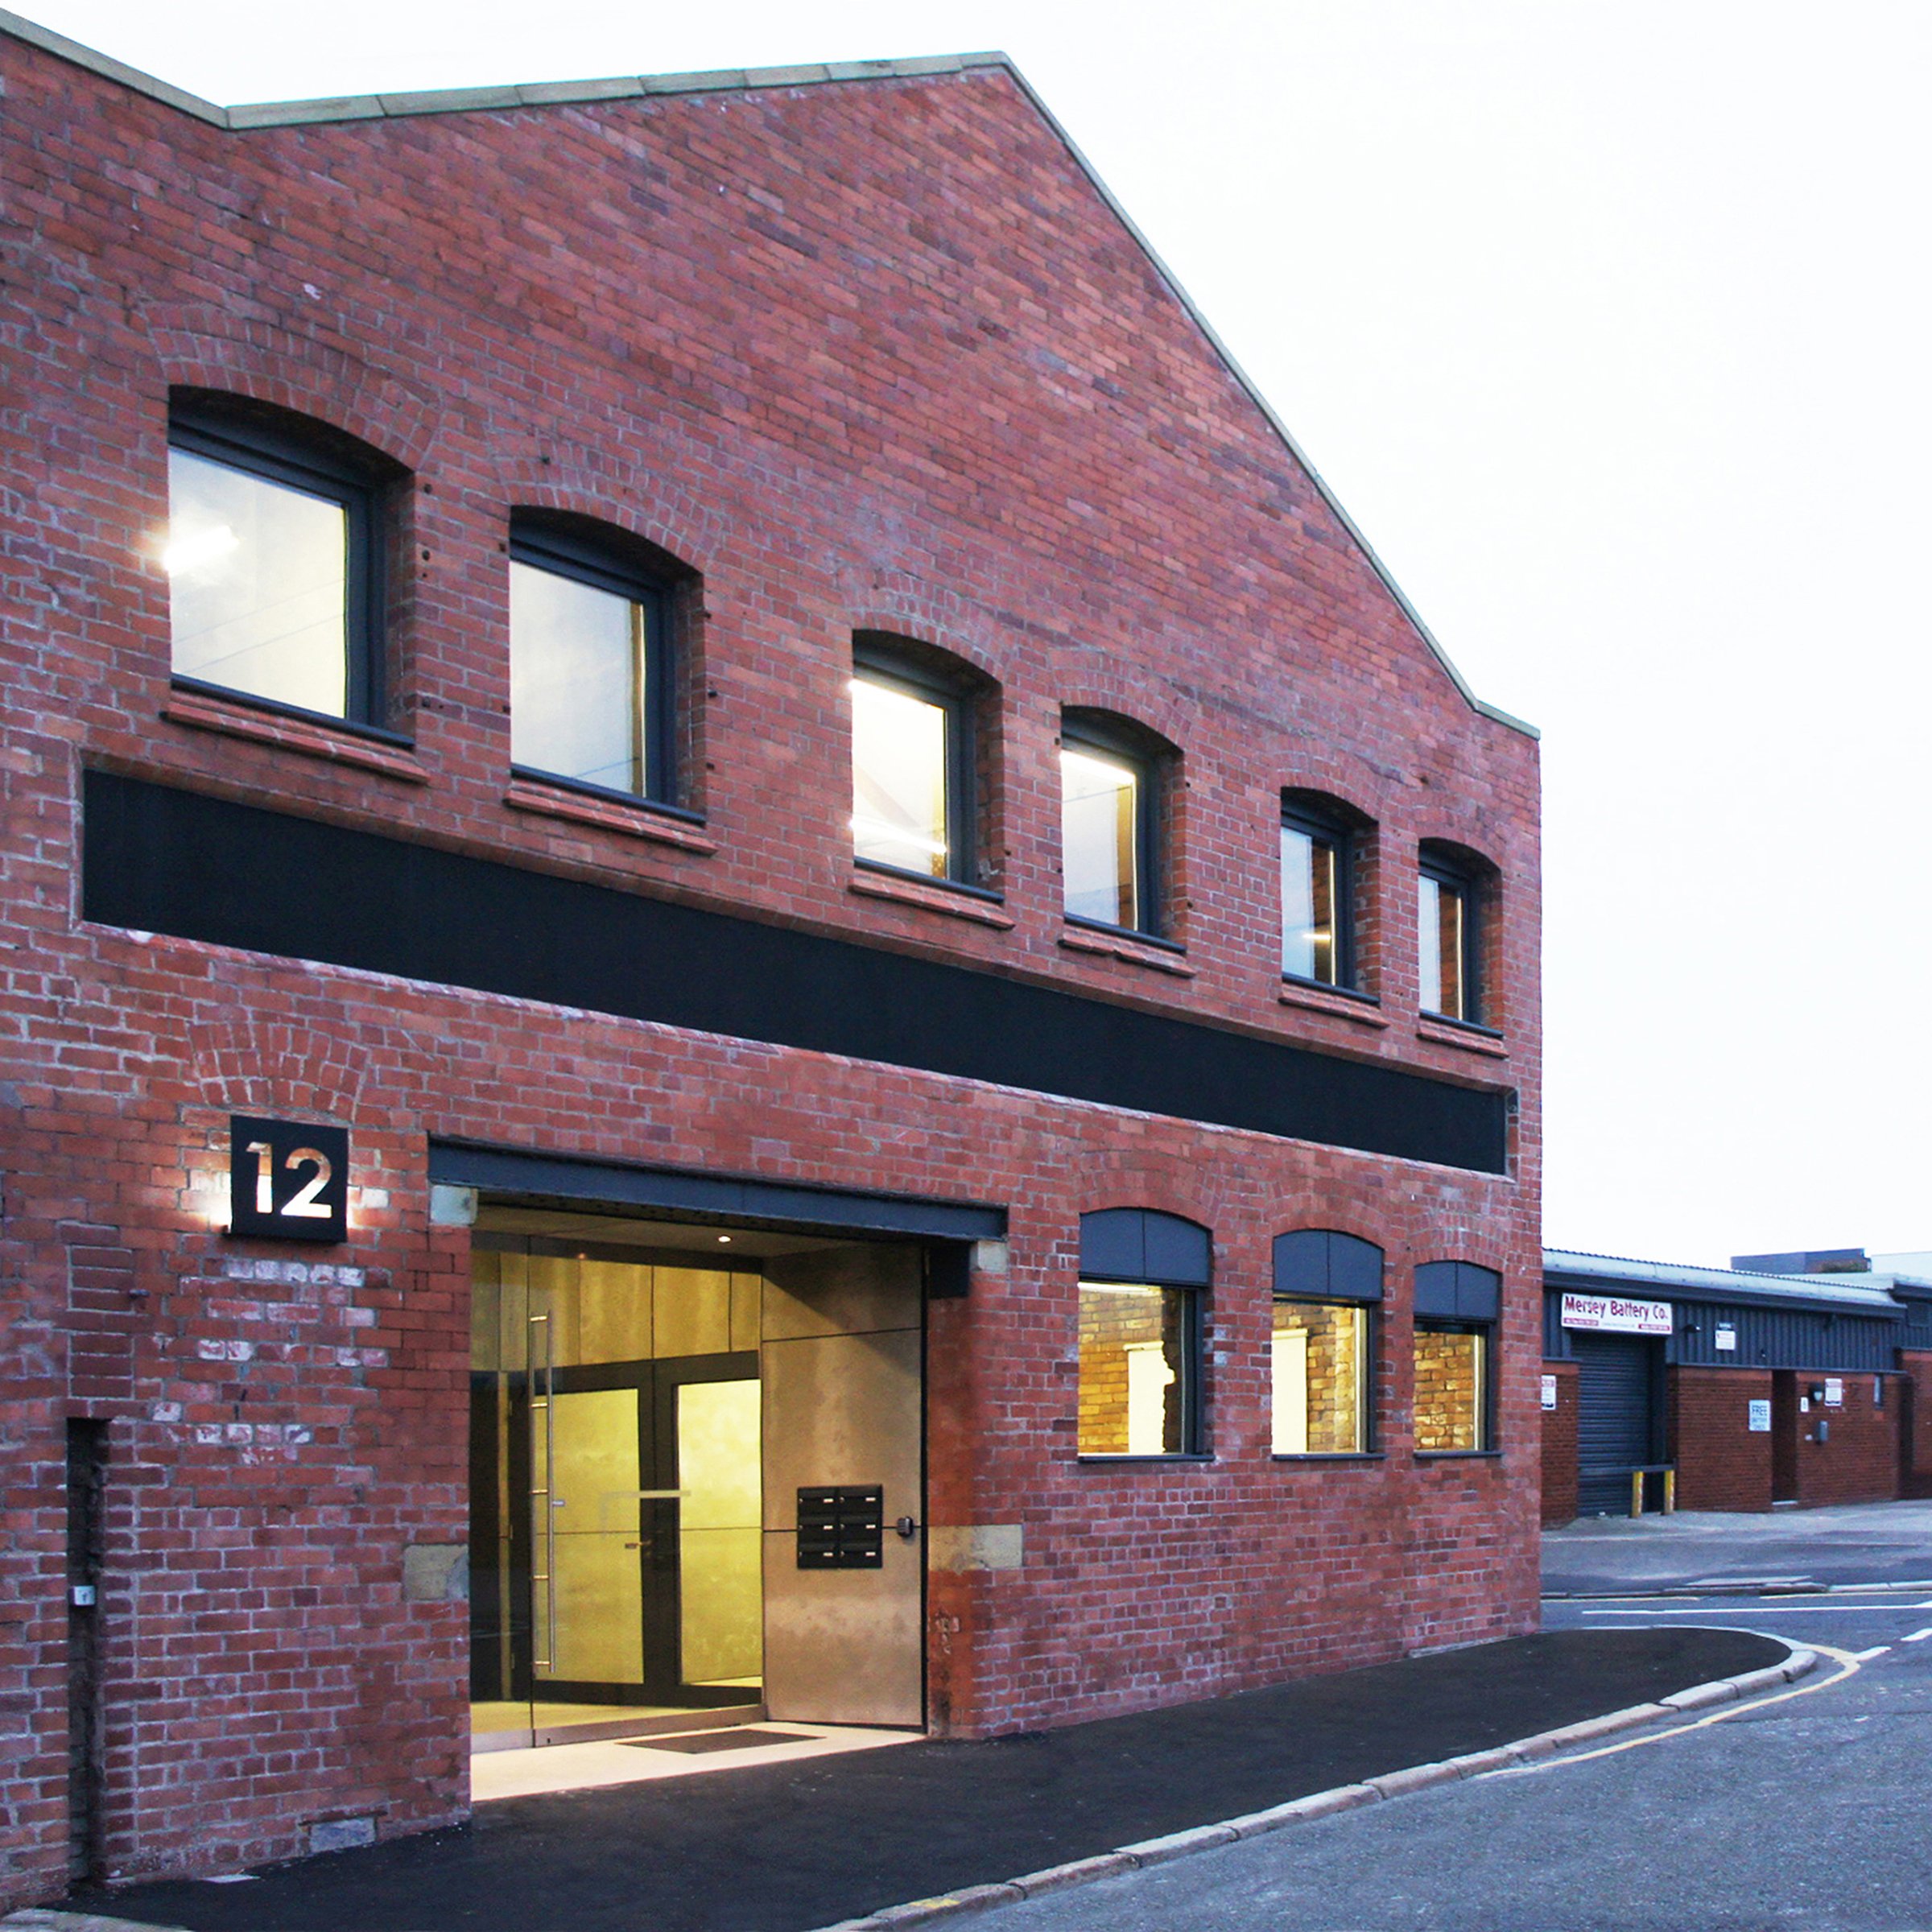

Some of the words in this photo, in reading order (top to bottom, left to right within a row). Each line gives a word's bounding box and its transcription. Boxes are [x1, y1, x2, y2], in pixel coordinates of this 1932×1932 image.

[246, 1141, 332, 1219] 12
[1564, 1296, 1606, 1319] Mersey
[1611, 1300, 1649, 1321] Battery
[1653, 1304, 1668, 1319] Co.
